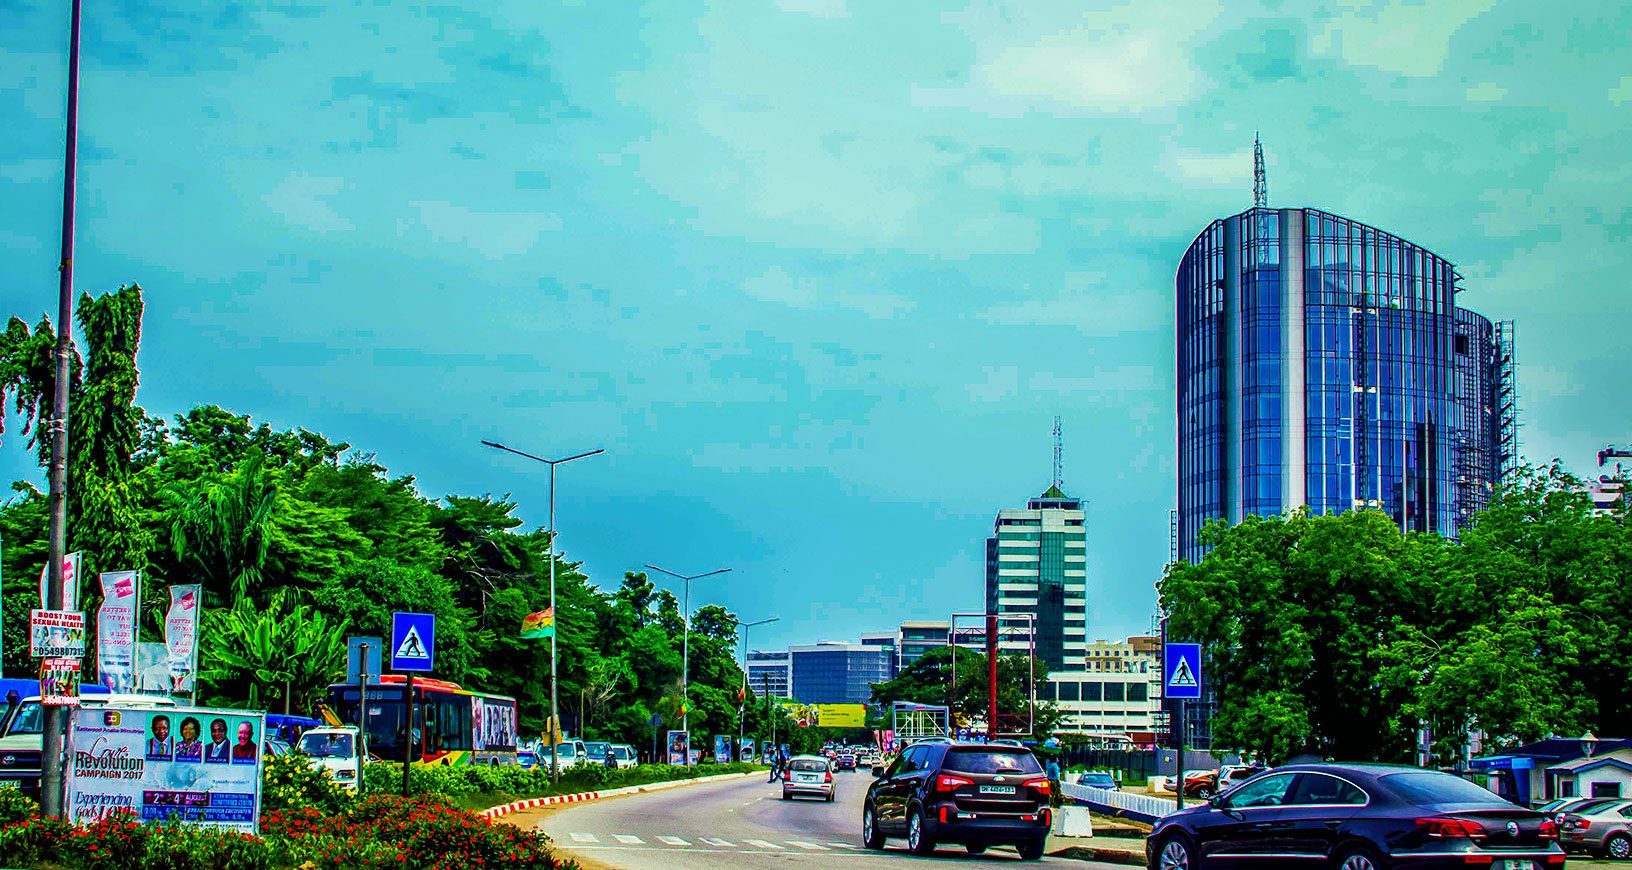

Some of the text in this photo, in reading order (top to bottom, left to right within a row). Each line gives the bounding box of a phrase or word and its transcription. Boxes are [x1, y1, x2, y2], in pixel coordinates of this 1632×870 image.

[38, 612, 63, 620] BOOST
[33, 618, 85, 629] SEXUAL HEALTH
[76, 751, 144, 771] Revolution
[76, 769, 143, 780] CAMPAIGN 2017
[76, 791, 133, 807] Experiencing
